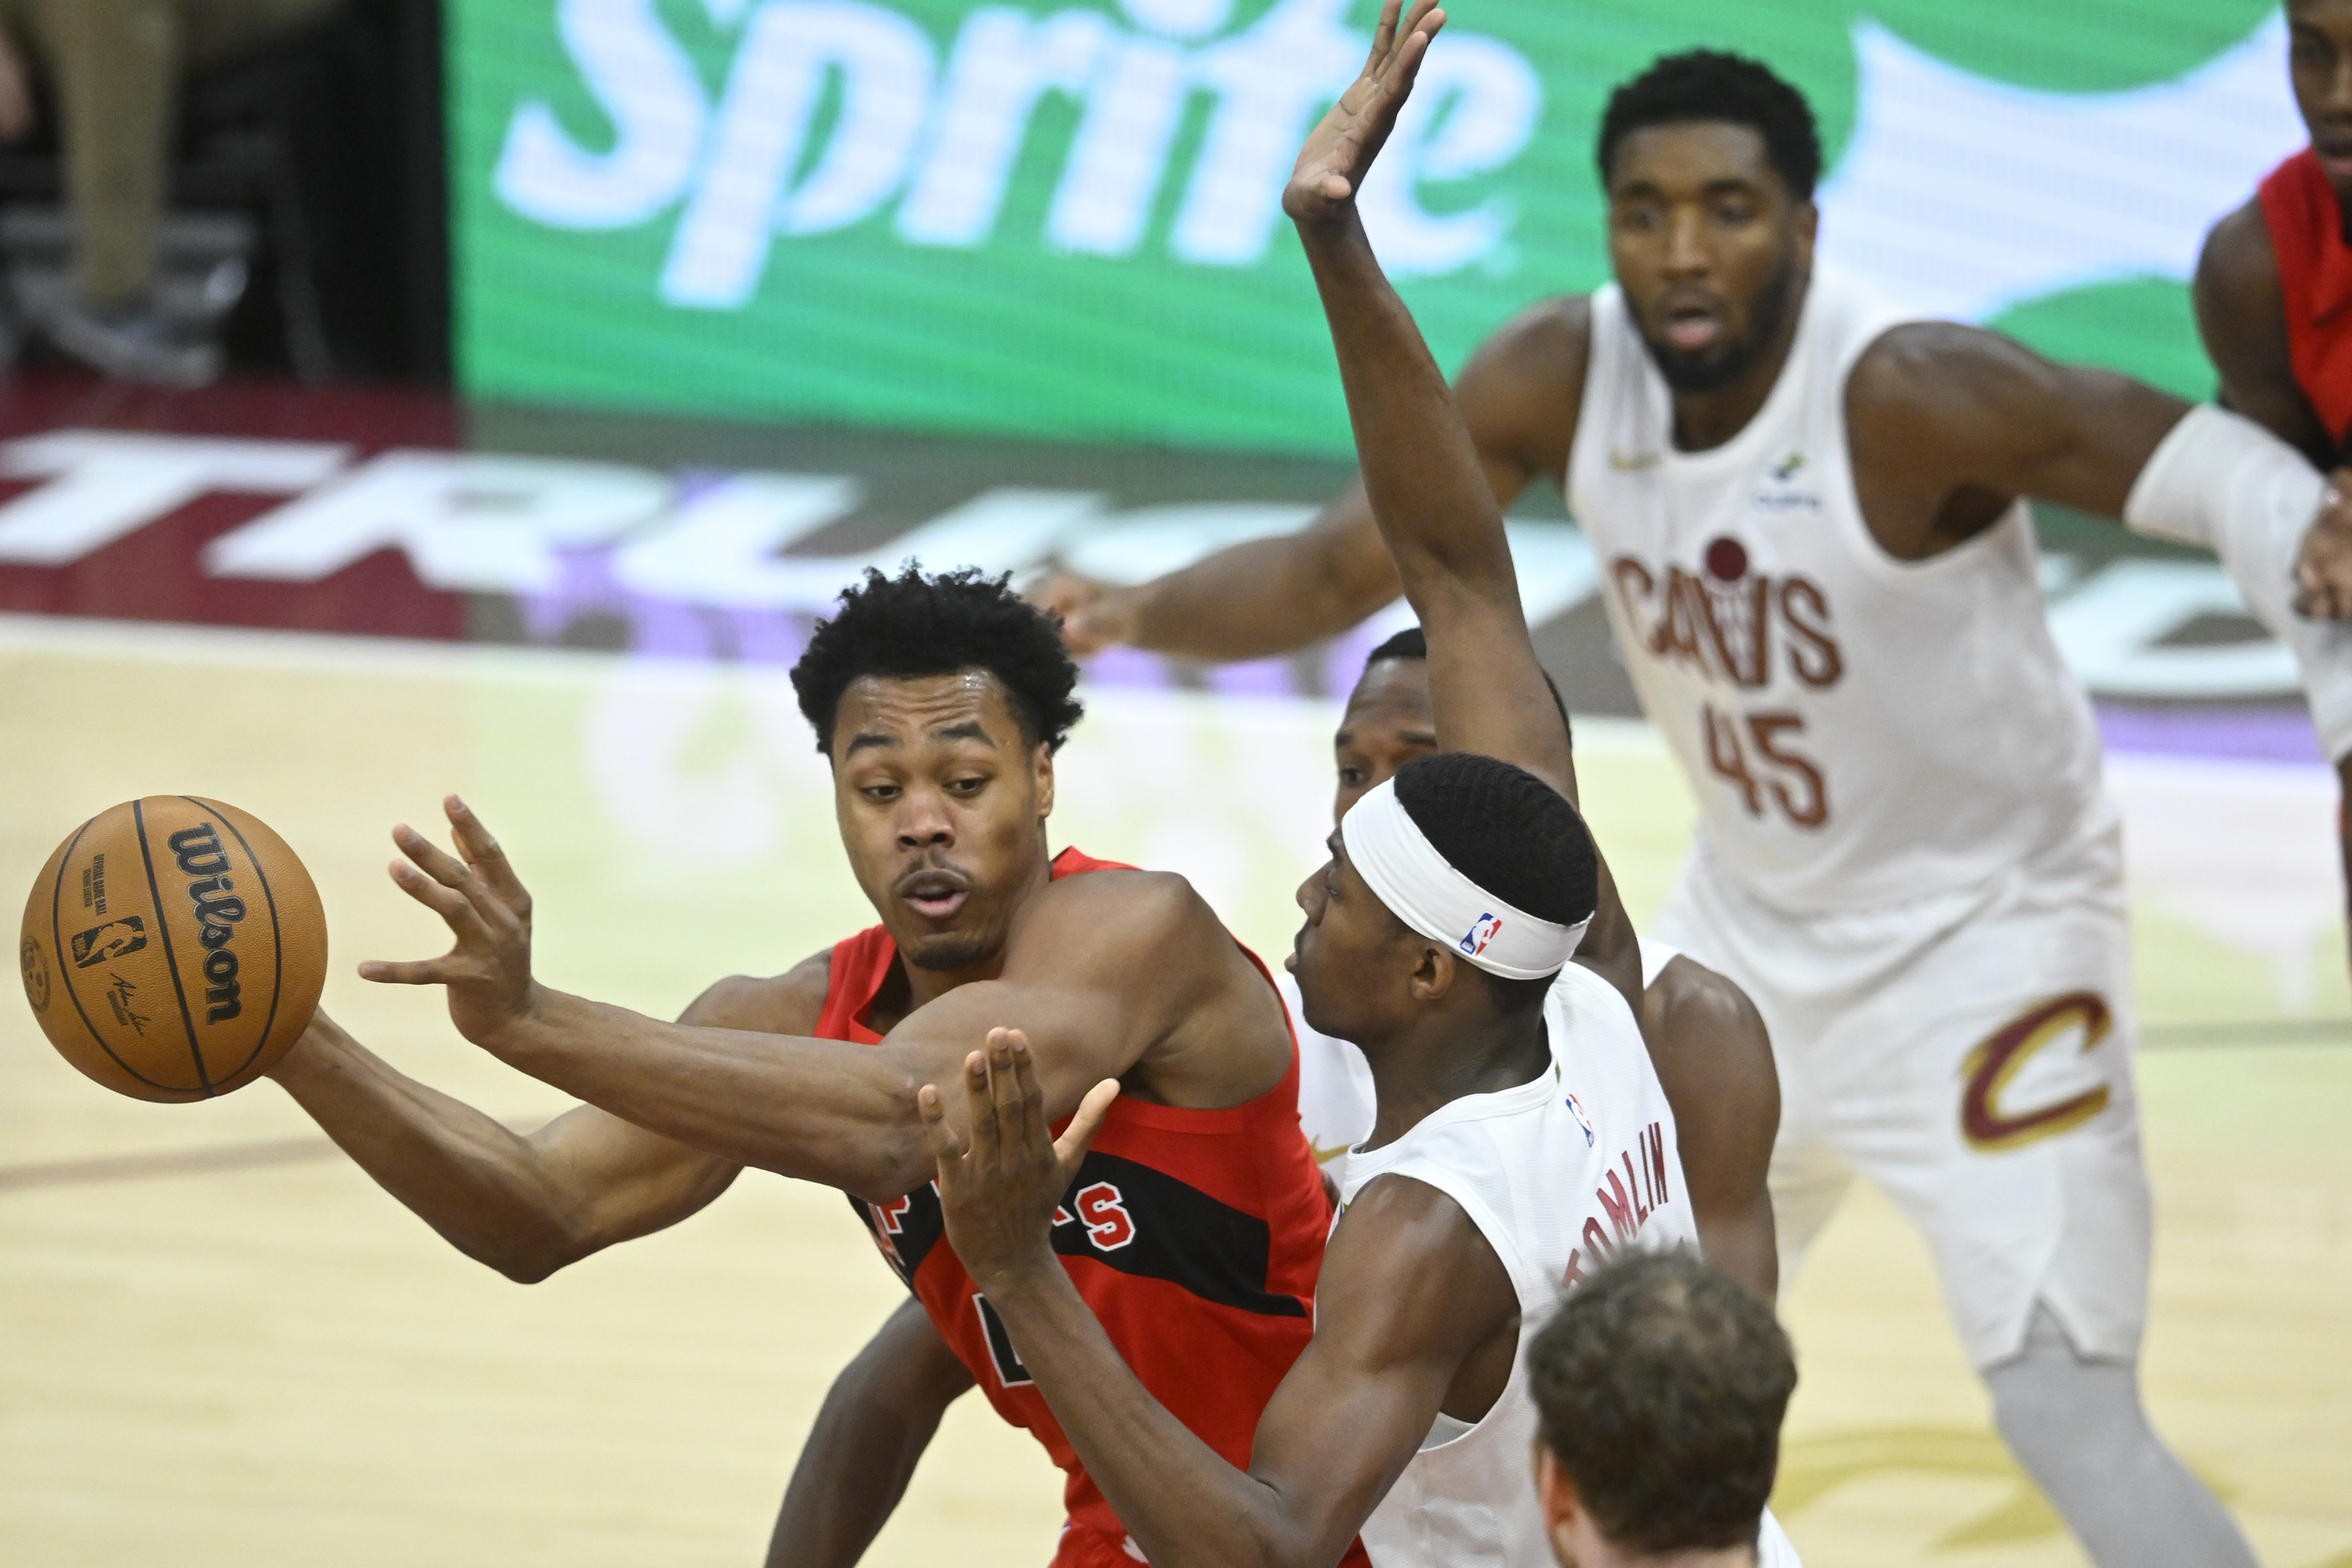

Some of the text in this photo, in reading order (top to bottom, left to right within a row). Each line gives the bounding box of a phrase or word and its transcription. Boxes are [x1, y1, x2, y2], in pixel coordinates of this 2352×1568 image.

[492, 0, 1541, 310] Sprite
[1610, 555, 1845, 691] CAVS
[1702, 702, 1829, 829] 45
[93, 880, 105, 899] GAME
[96, 900, 107, 916] BALL
[167, 822, 246, 1025] Wilson
[1561, 1121, 1669, 1290] TOMLIN
